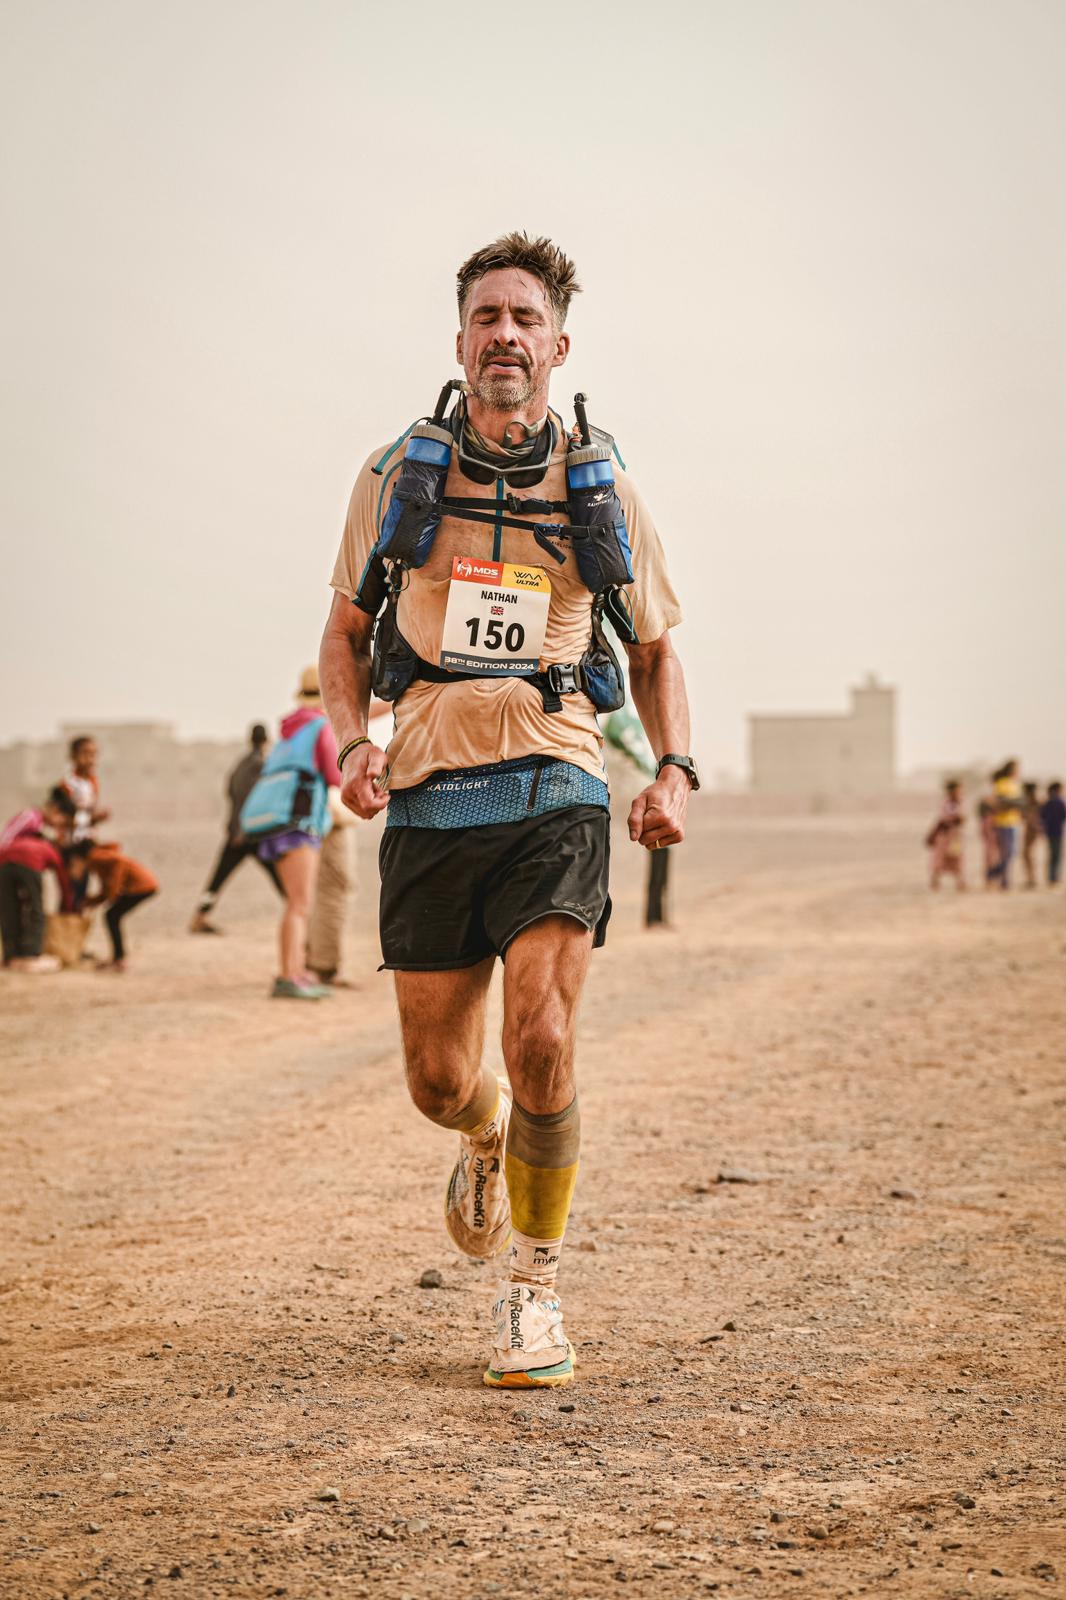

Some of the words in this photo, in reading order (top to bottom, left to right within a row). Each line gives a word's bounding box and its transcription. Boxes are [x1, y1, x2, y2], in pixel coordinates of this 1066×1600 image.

[473, 566, 498, 576] MDS
[516, 579, 539, 587] ULTRA
[480, 590, 518, 604] NATHAN
[465, 617, 525, 652] 150
[444, 656, 465, 665] 38TH
[466, 660, 508, 669] EDITION
[473, 1157, 487, 1229] myRaceKit
[508, 1288, 524, 1349] myRaceKit
